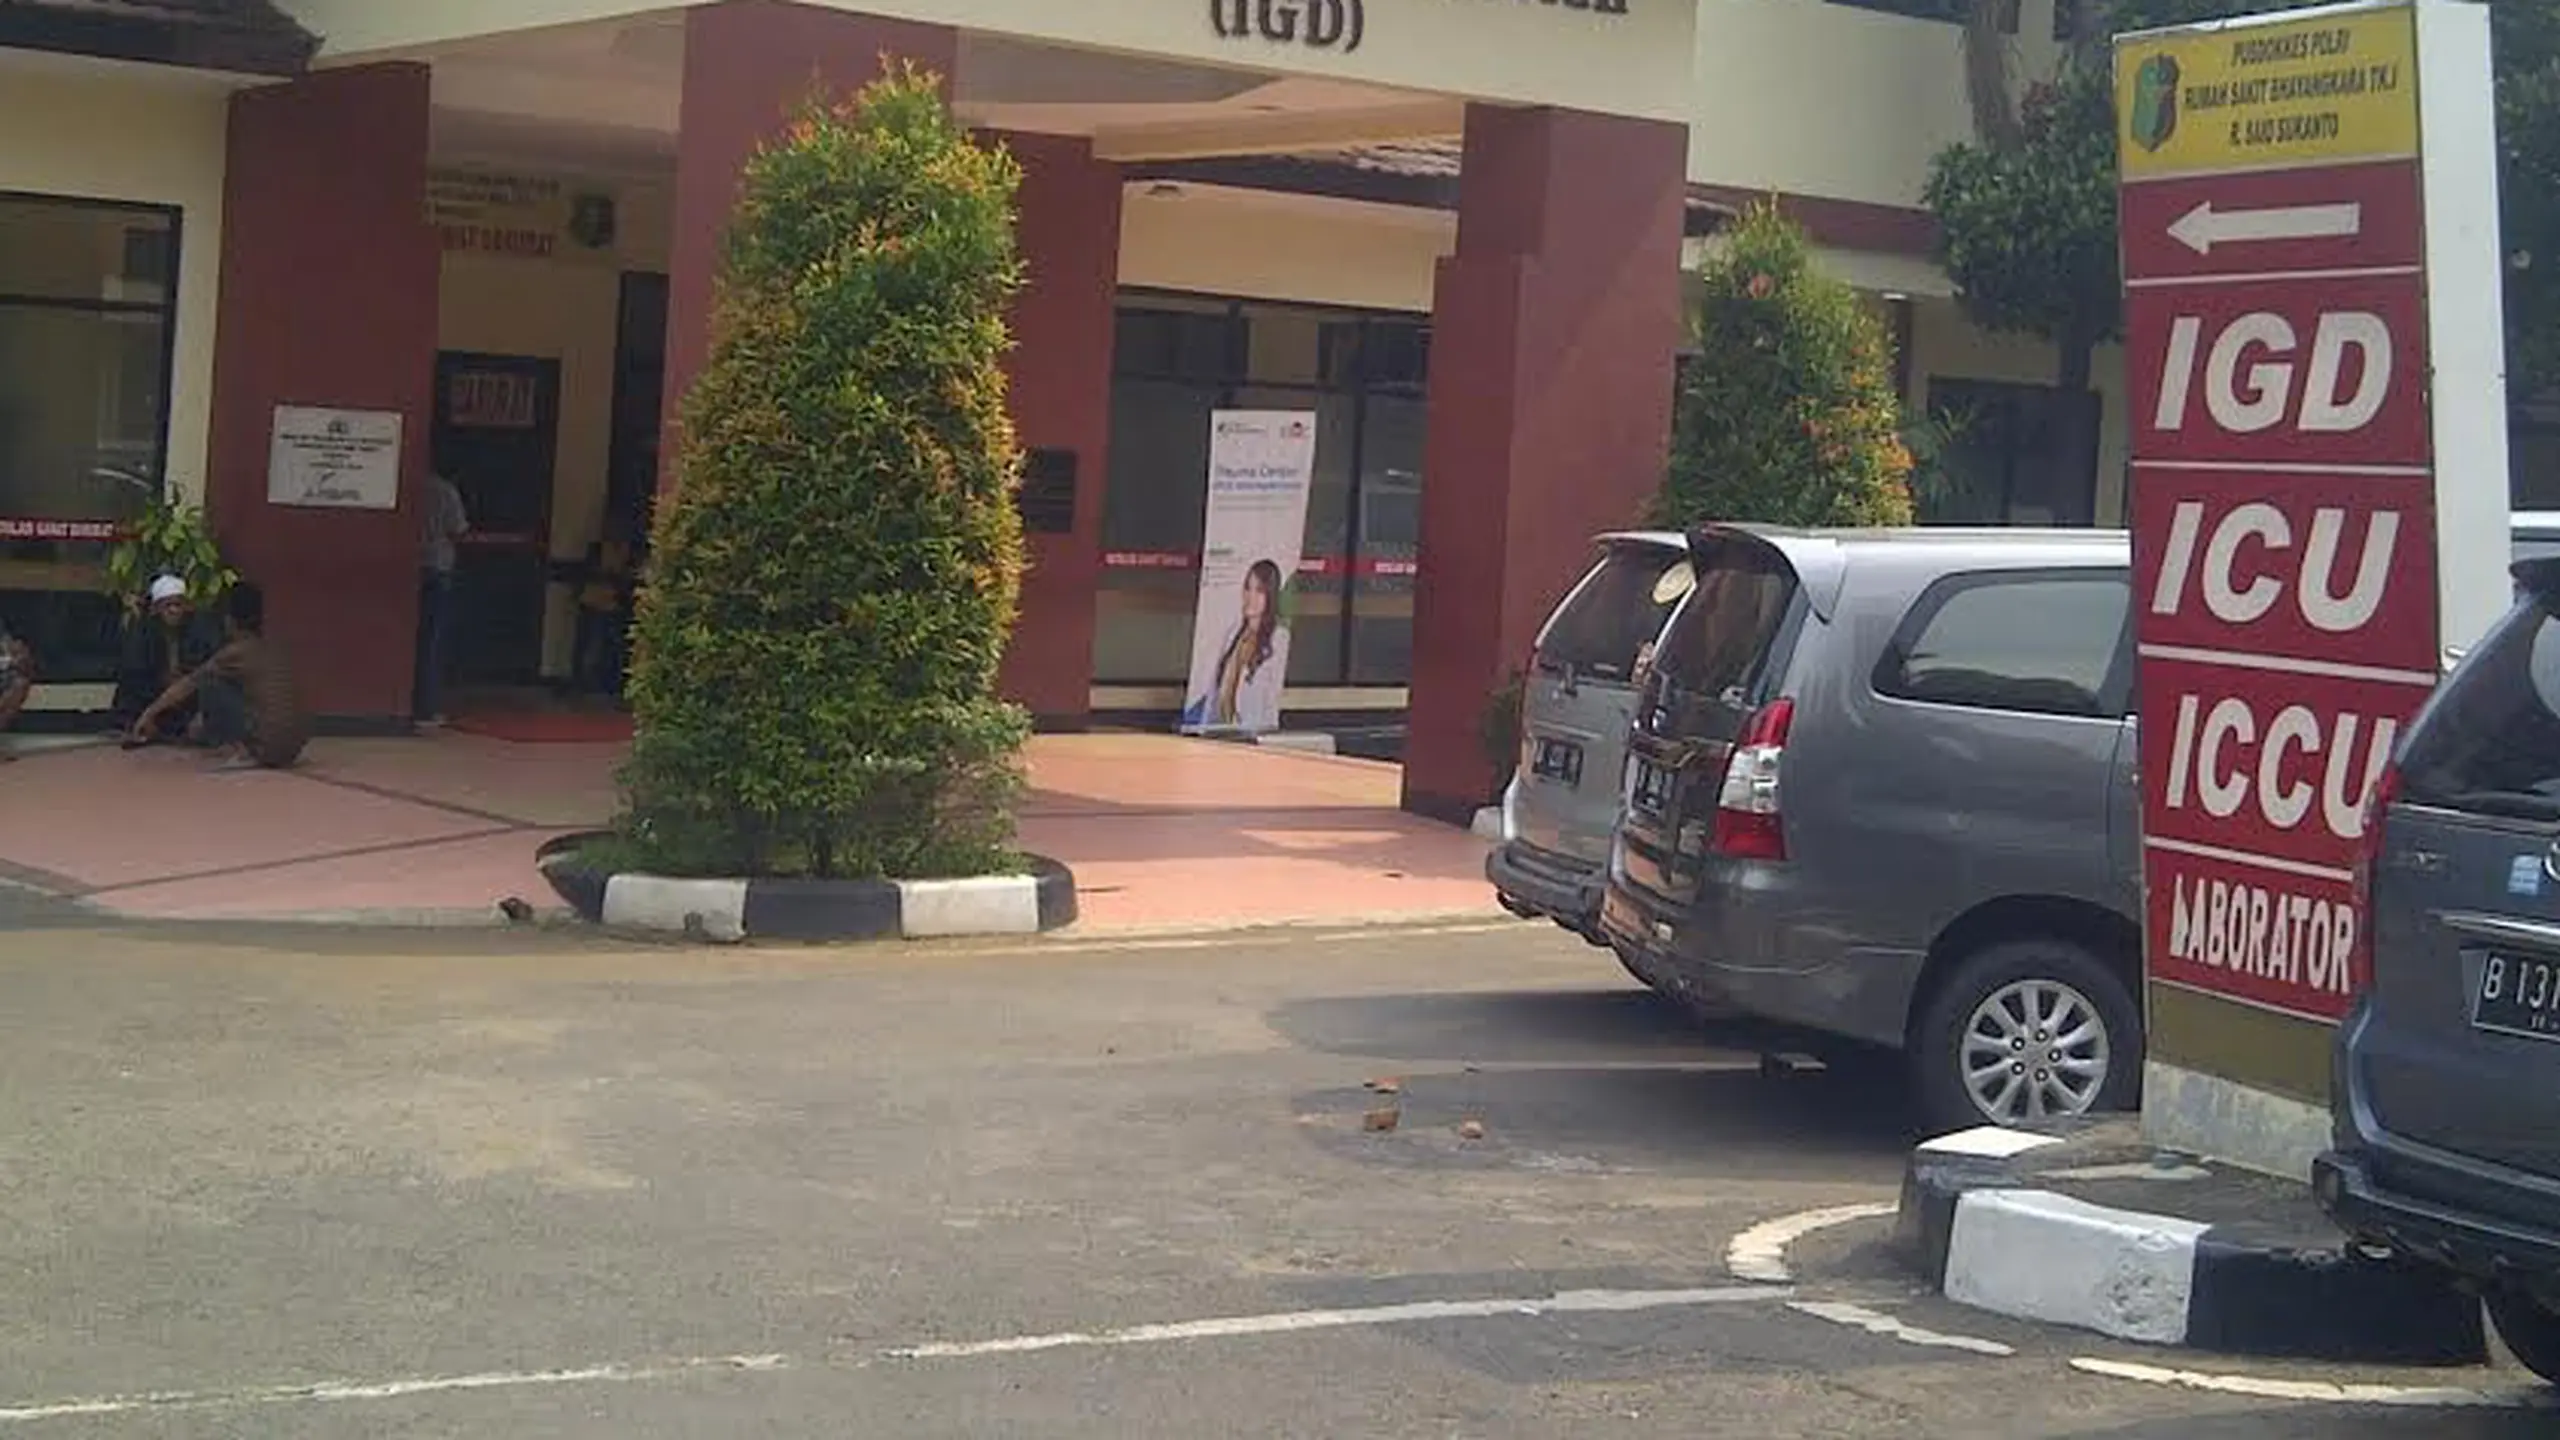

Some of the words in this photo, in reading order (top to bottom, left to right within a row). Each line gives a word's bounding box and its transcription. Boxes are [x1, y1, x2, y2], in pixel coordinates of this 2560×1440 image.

[1210, 0, 1365, 53] (IGD)
[2154, 311, 2393, 433] IGD
[2151, 501, 2400, 633] ICU
[2165, 694, 2398, 839] ICCU
[2483, 956, 2505, 1000] B
